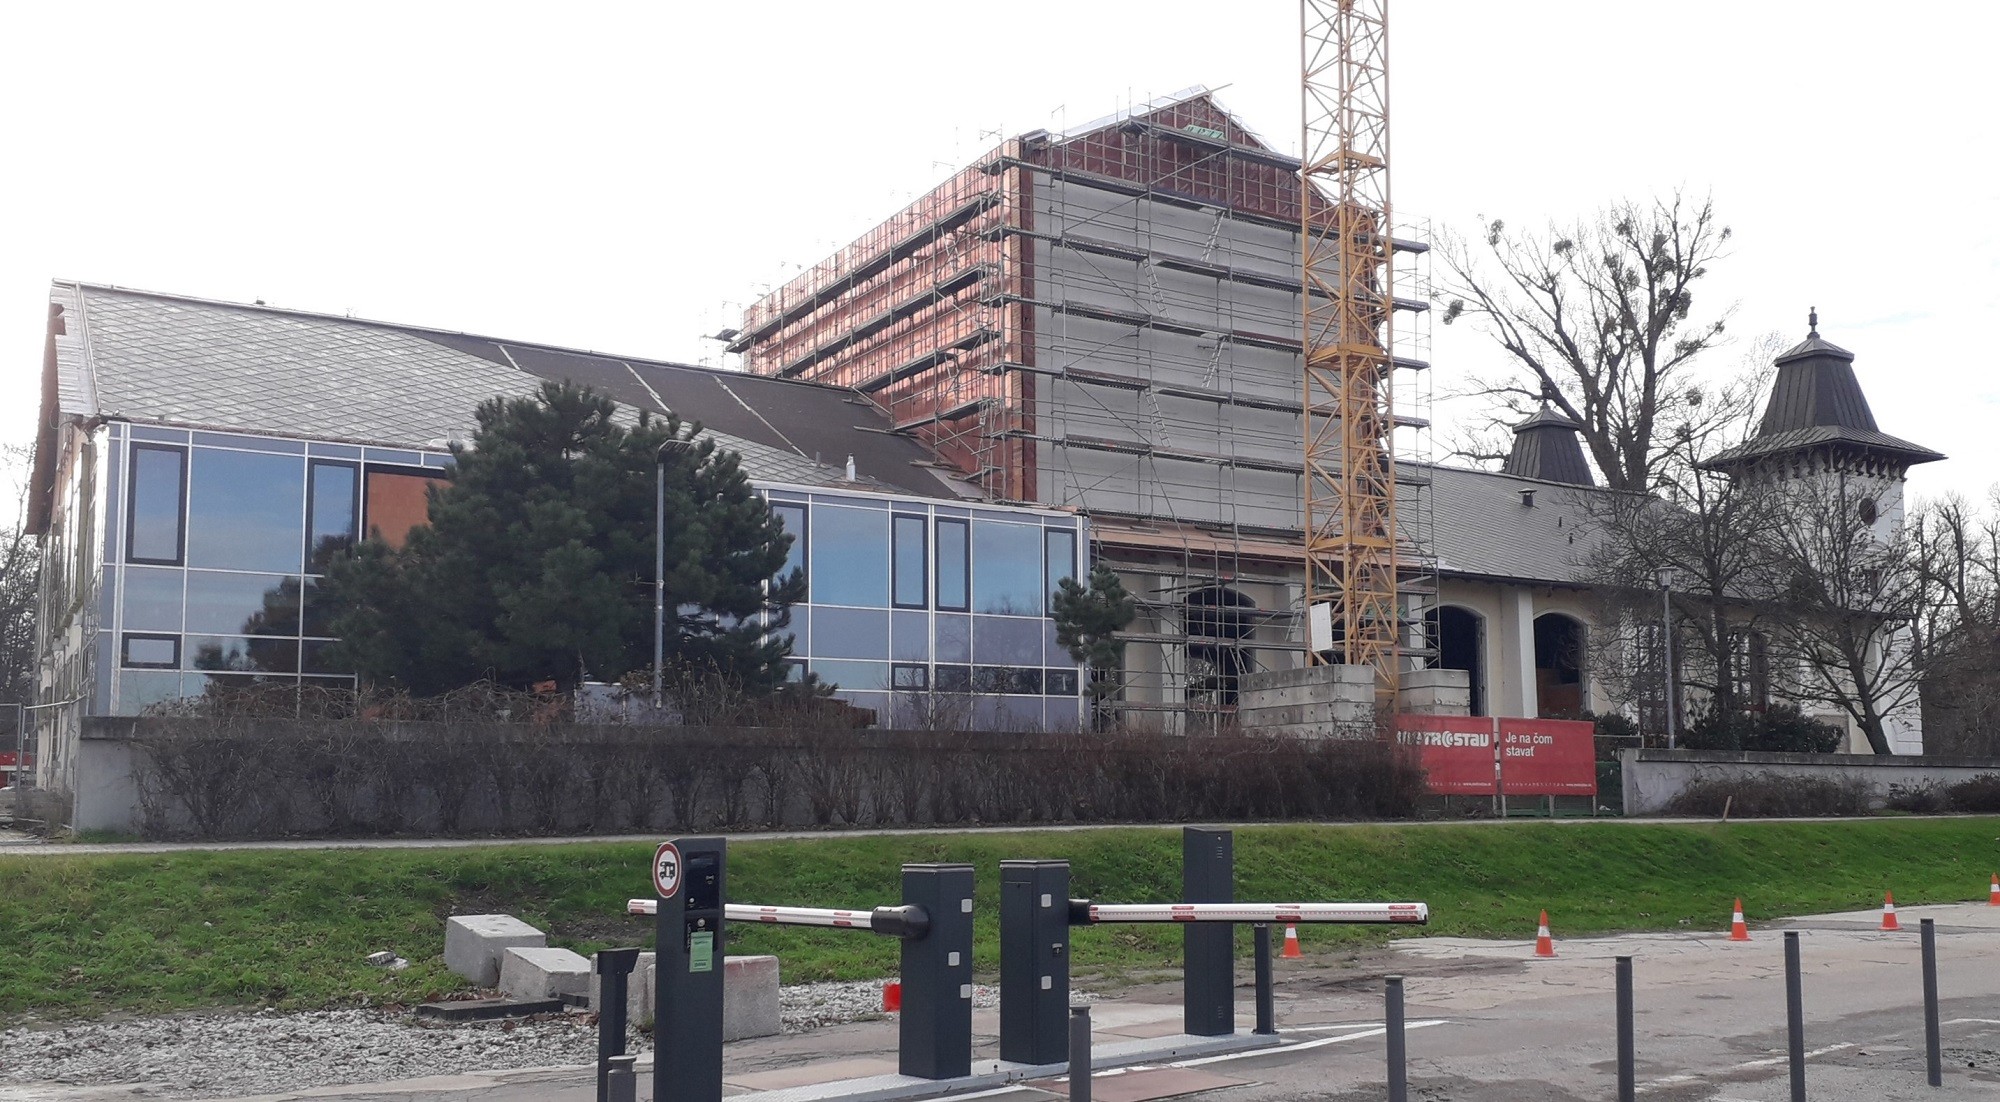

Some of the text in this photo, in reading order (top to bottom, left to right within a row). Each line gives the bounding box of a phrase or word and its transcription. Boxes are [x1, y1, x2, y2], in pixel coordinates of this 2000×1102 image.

[1505, 731, 1553, 744] Je na čom
